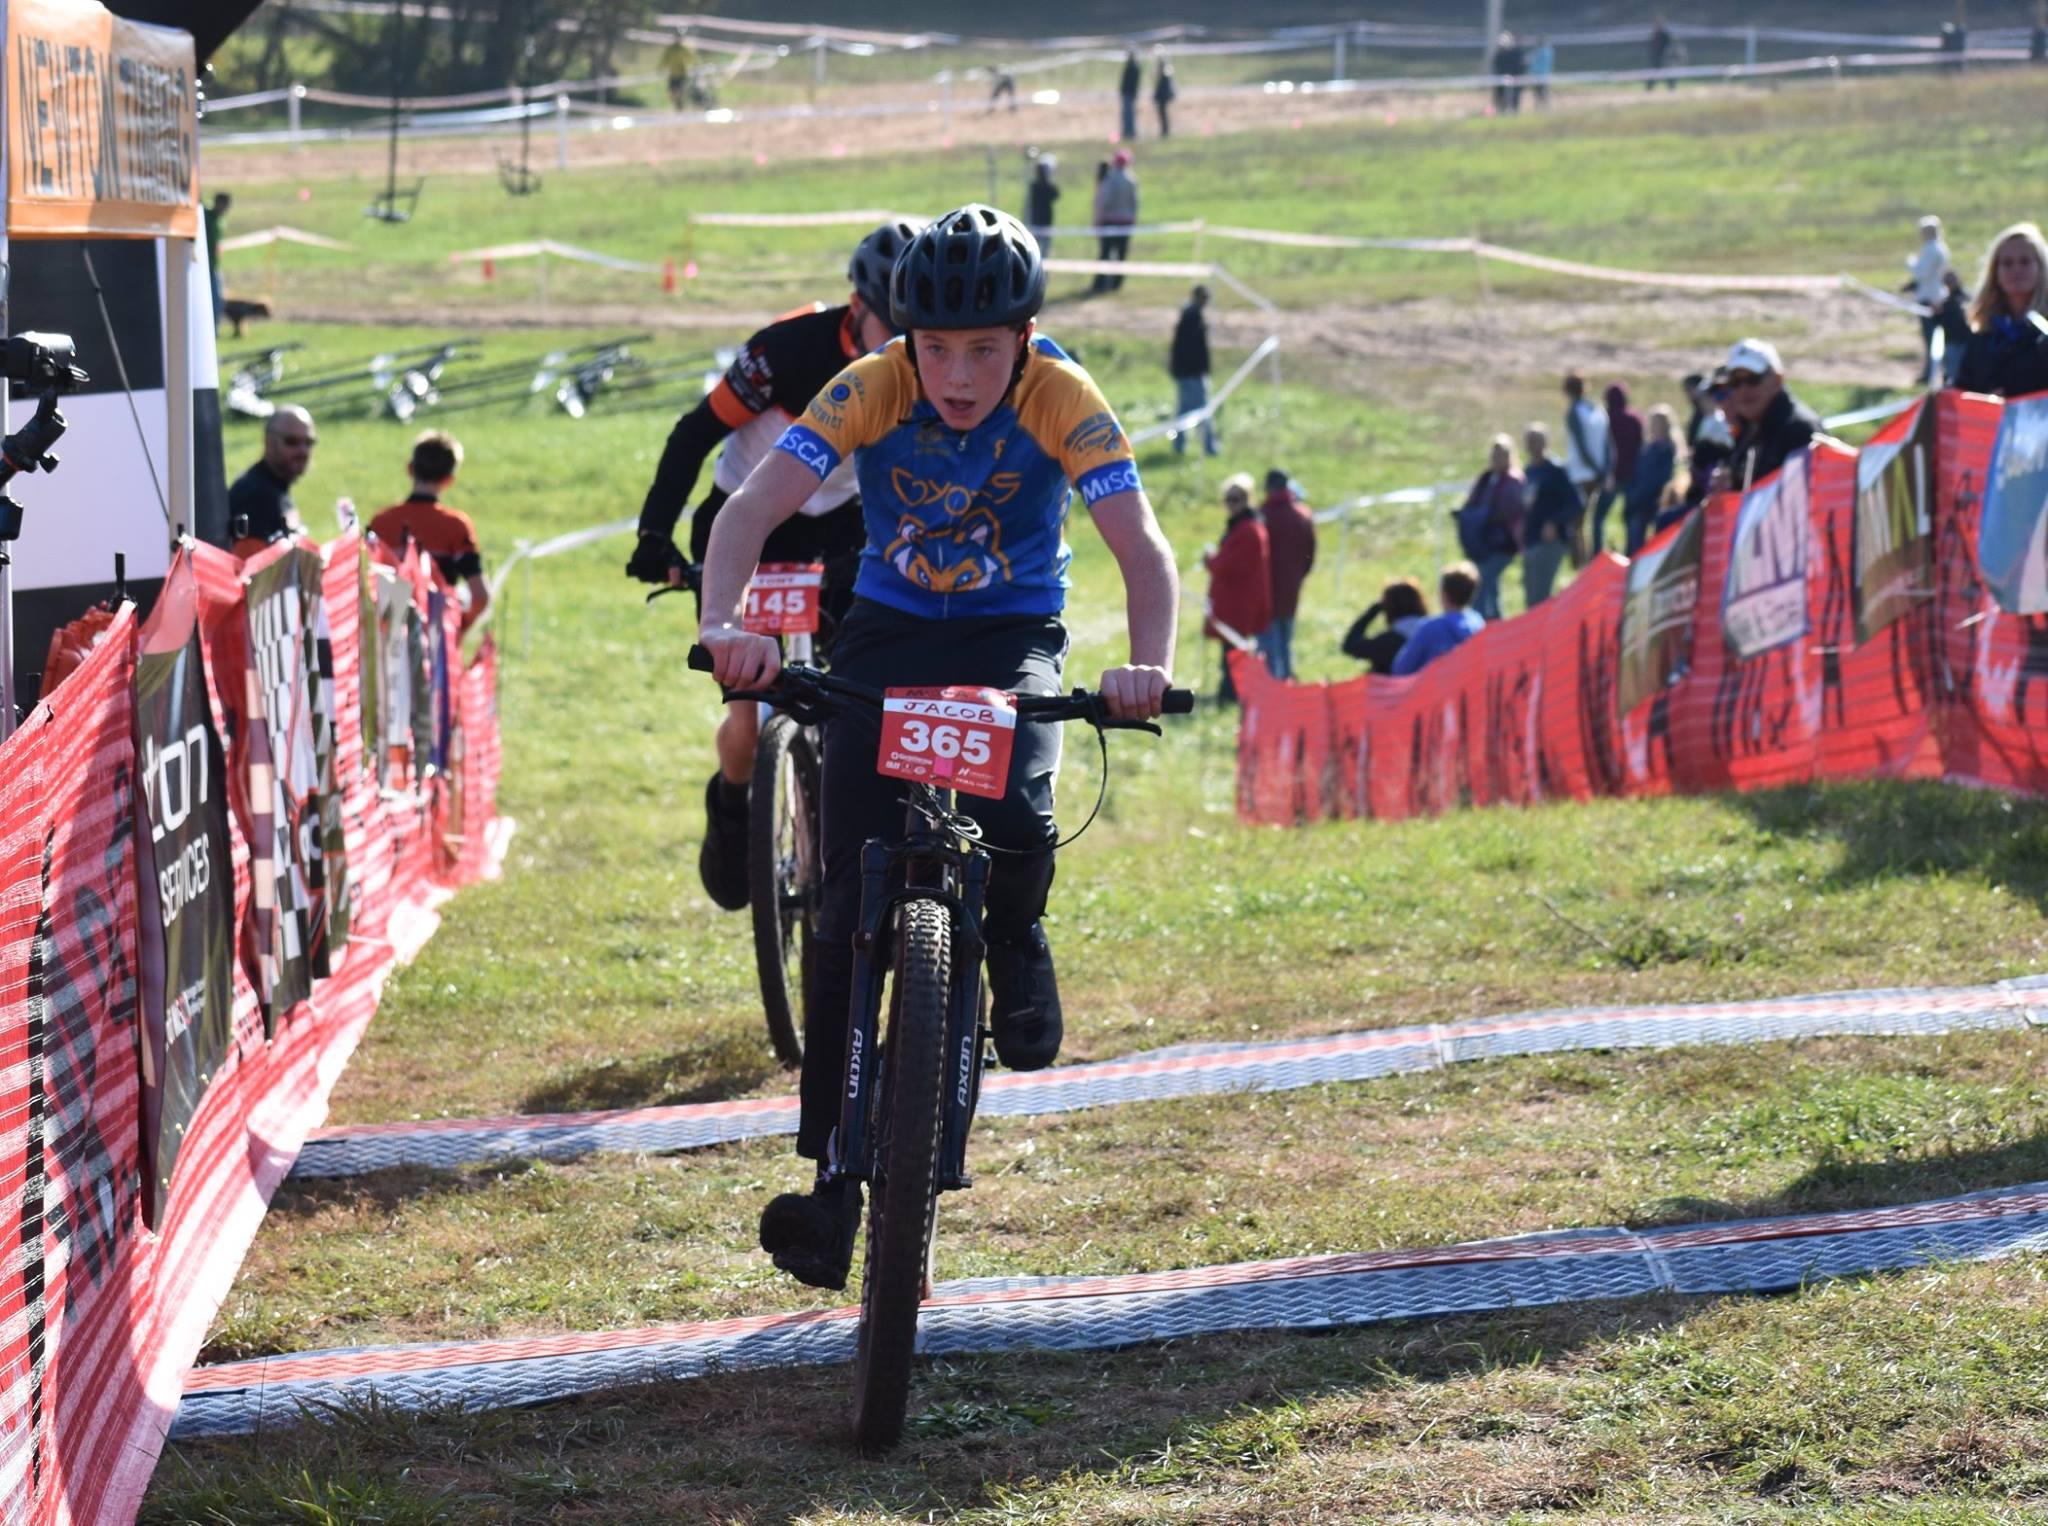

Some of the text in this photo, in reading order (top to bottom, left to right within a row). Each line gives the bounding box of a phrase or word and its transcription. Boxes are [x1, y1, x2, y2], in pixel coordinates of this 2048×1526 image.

[748, 590, 806, 616] 145
[903, 700, 996, 724] JACOB
[900, 720, 992, 766] 365
[848, 1028, 863, 1099] AXON
[957, 1035, 972, 1107] AXON
